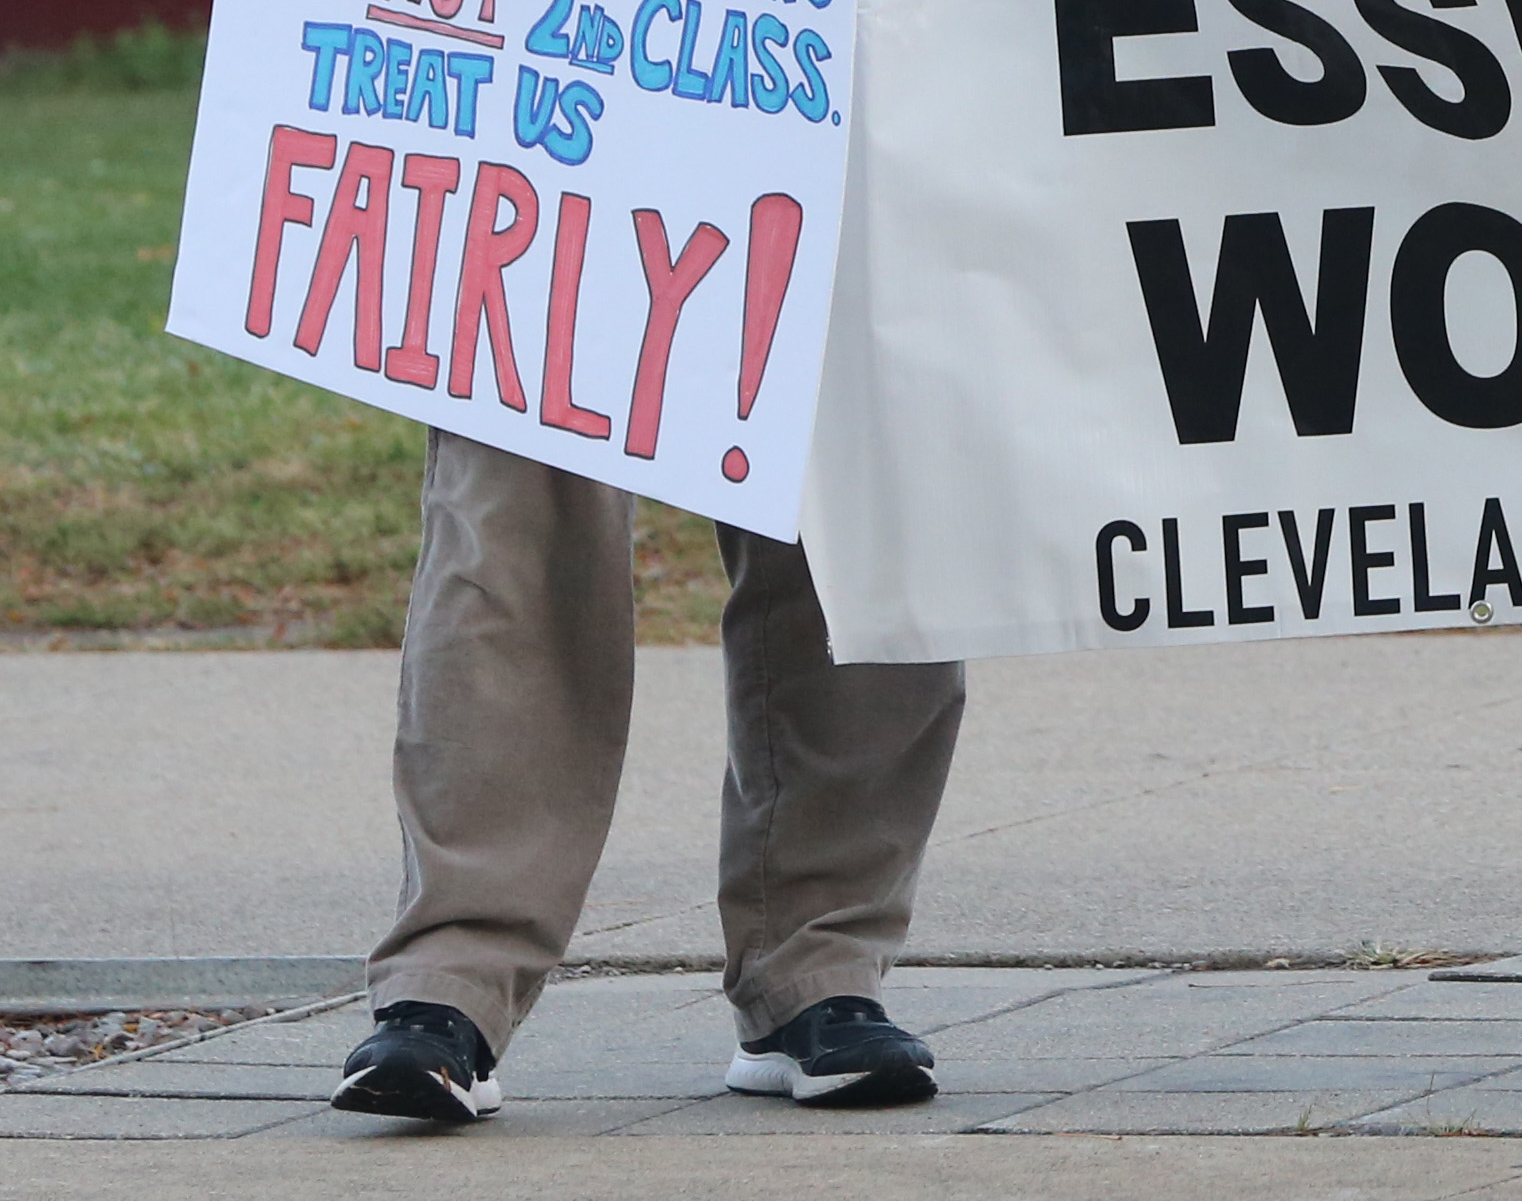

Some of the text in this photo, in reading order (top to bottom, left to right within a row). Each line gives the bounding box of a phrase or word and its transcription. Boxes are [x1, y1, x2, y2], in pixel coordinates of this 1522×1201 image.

[301, 22, 605, 167] TREAT US
[244, 125, 803, 483] FAIRLY!
